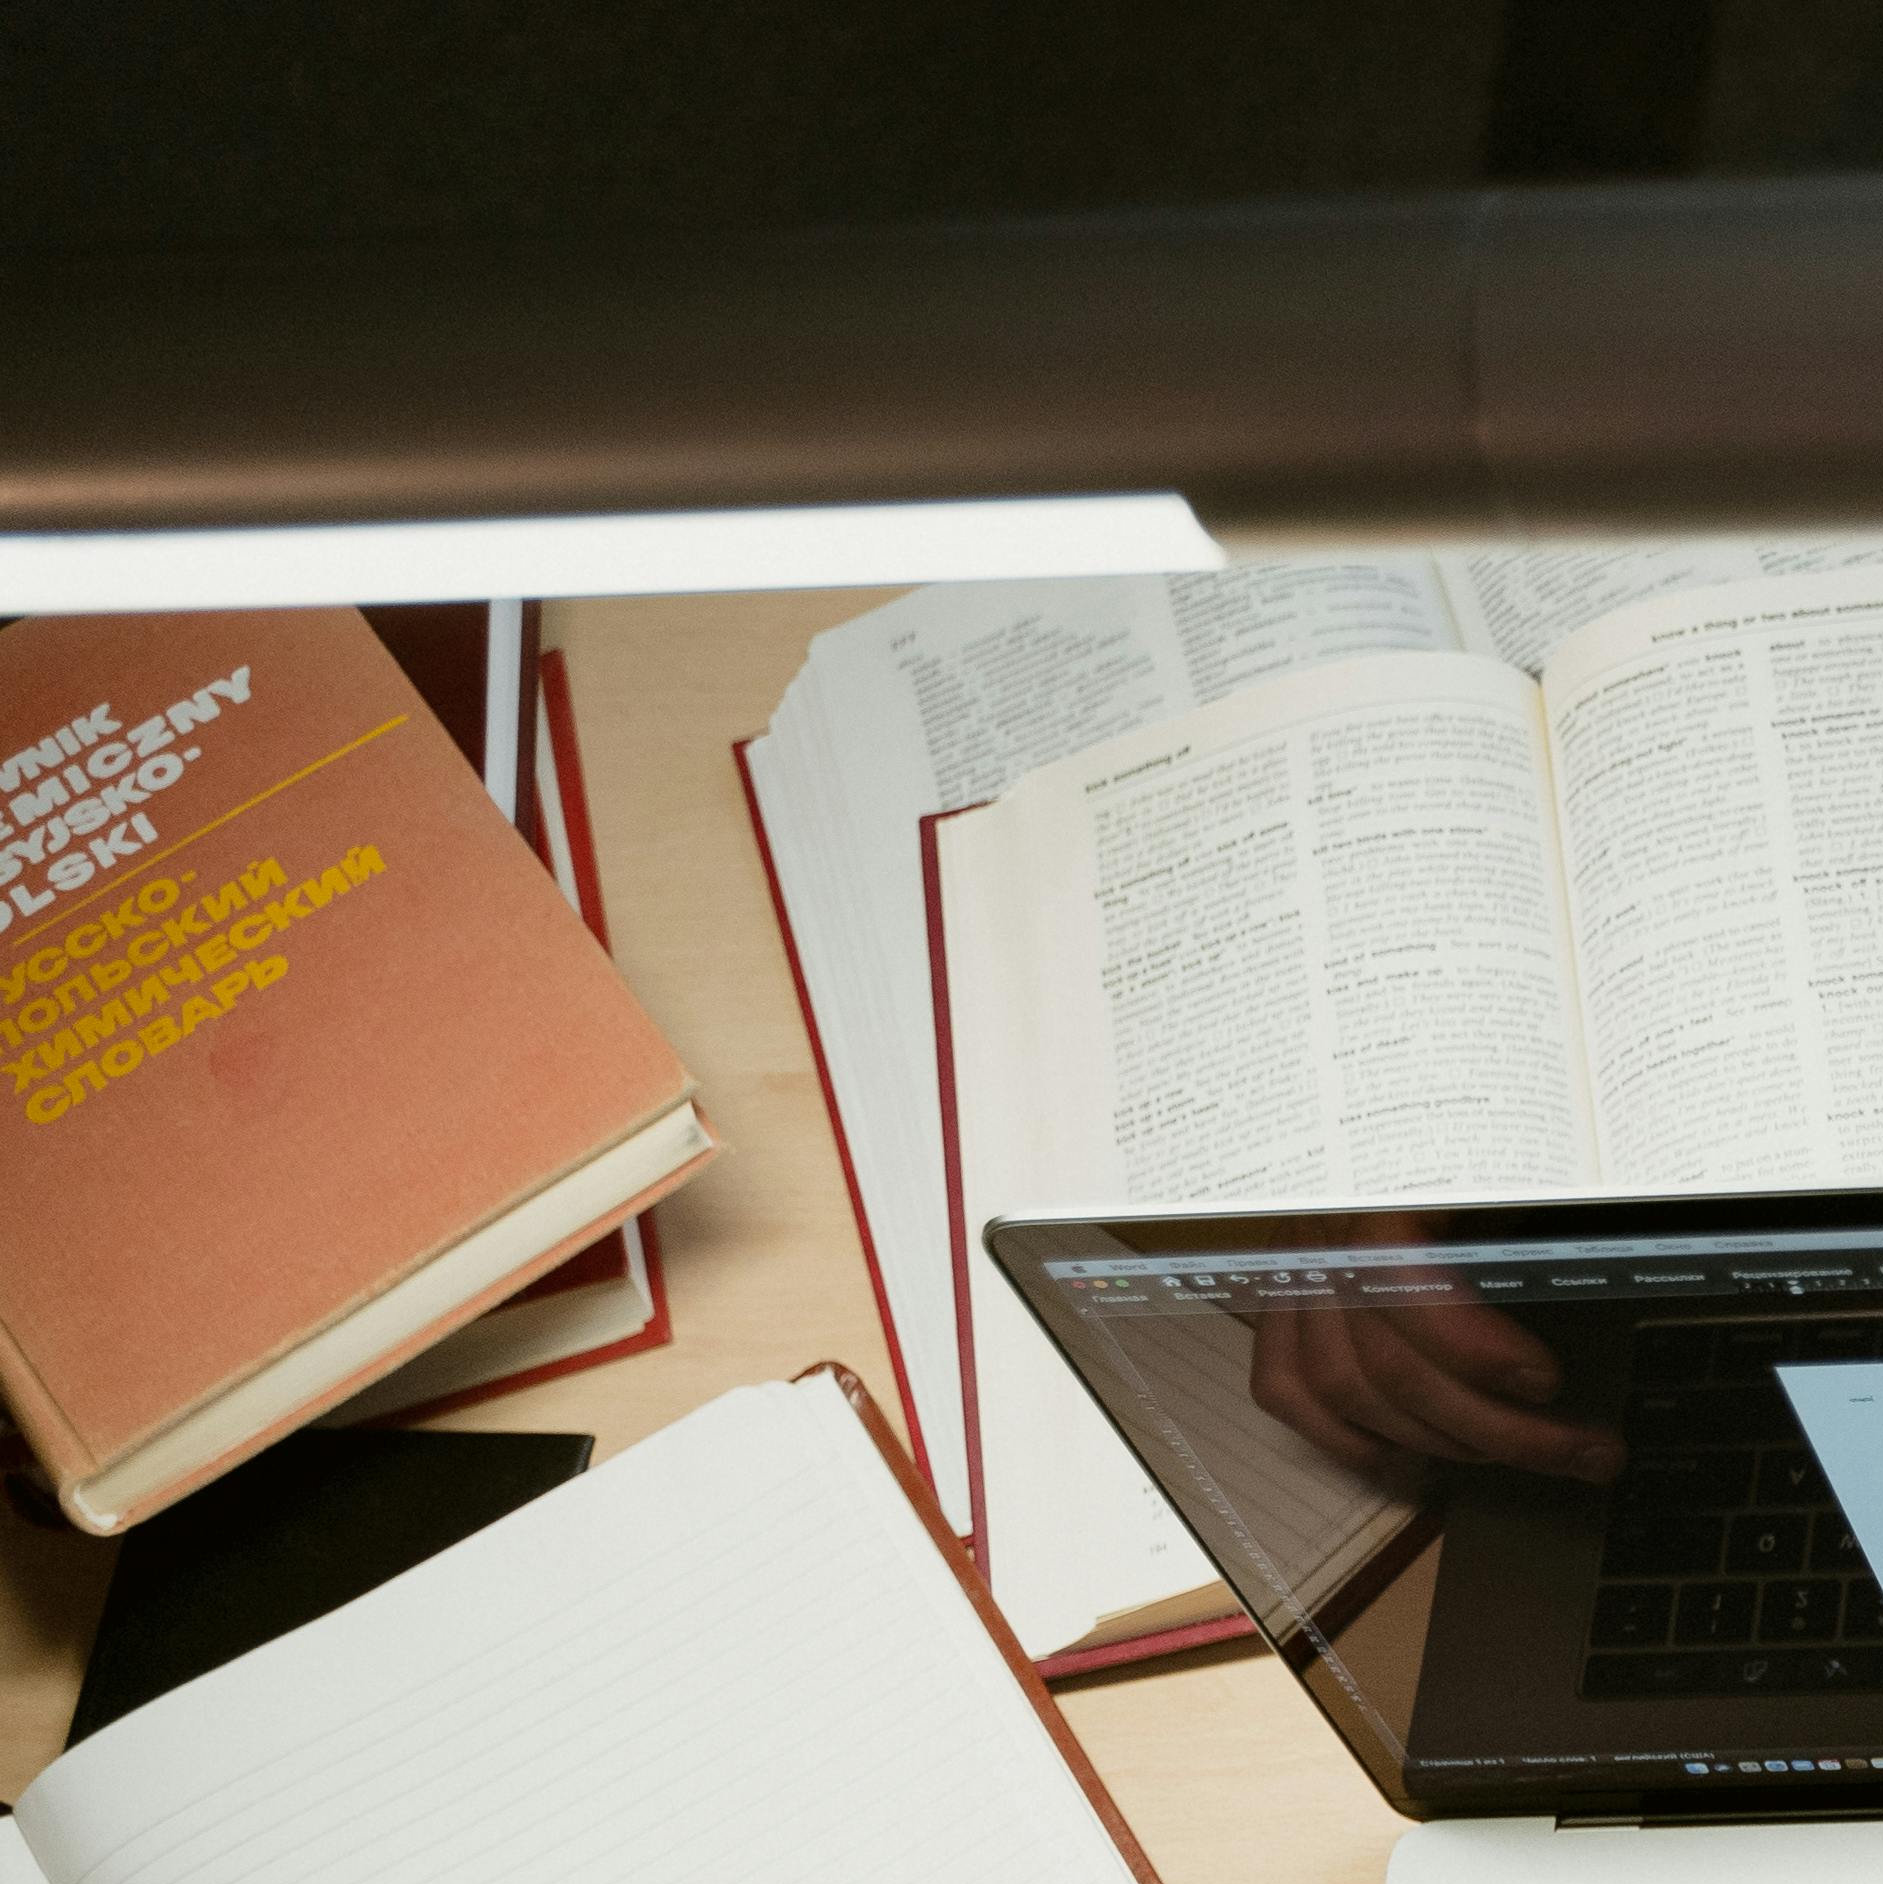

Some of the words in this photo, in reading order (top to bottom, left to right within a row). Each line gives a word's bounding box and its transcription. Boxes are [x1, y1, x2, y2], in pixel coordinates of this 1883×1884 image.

[1790, 606, 1831, 619] about
[0, 665, 251, 841] MICZNY
[0, 812, 158, 934] LSKI
[1, 844, 386, 1094] ХИМИЧЕСКИЙ
[25, 954, 289, 1124] СЛОВАРЬ
[1362, 1282, 1453, 1295] Конструктор
